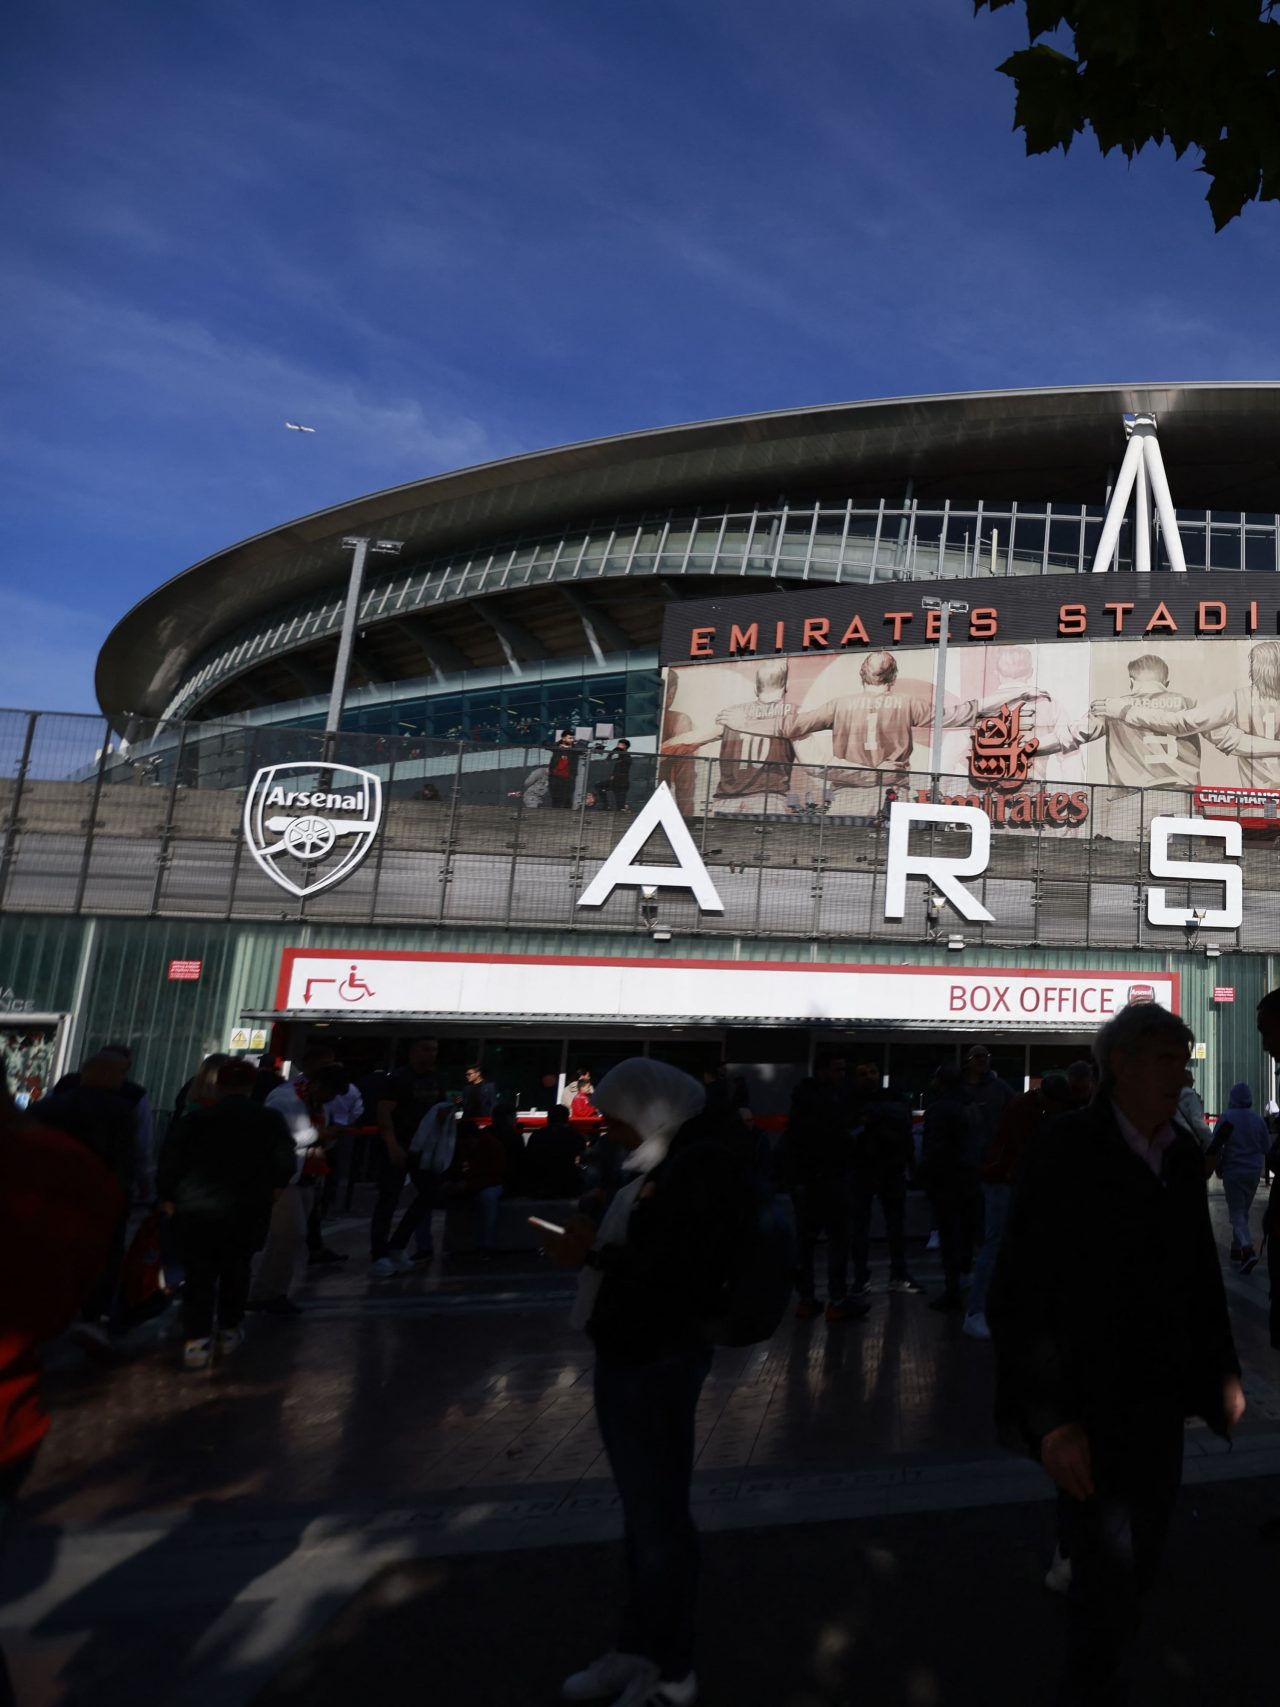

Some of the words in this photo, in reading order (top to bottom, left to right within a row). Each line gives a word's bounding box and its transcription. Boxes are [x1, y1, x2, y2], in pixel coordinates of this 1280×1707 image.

[689, 607, 998, 656] EMIRATES
[265, 786, 364, 811] Arsenal
[916, 786, 1089, 822] irates
[949, 984, 1011, 1012] BOX
[1019, 986, 1115, 1014] OFFICE
